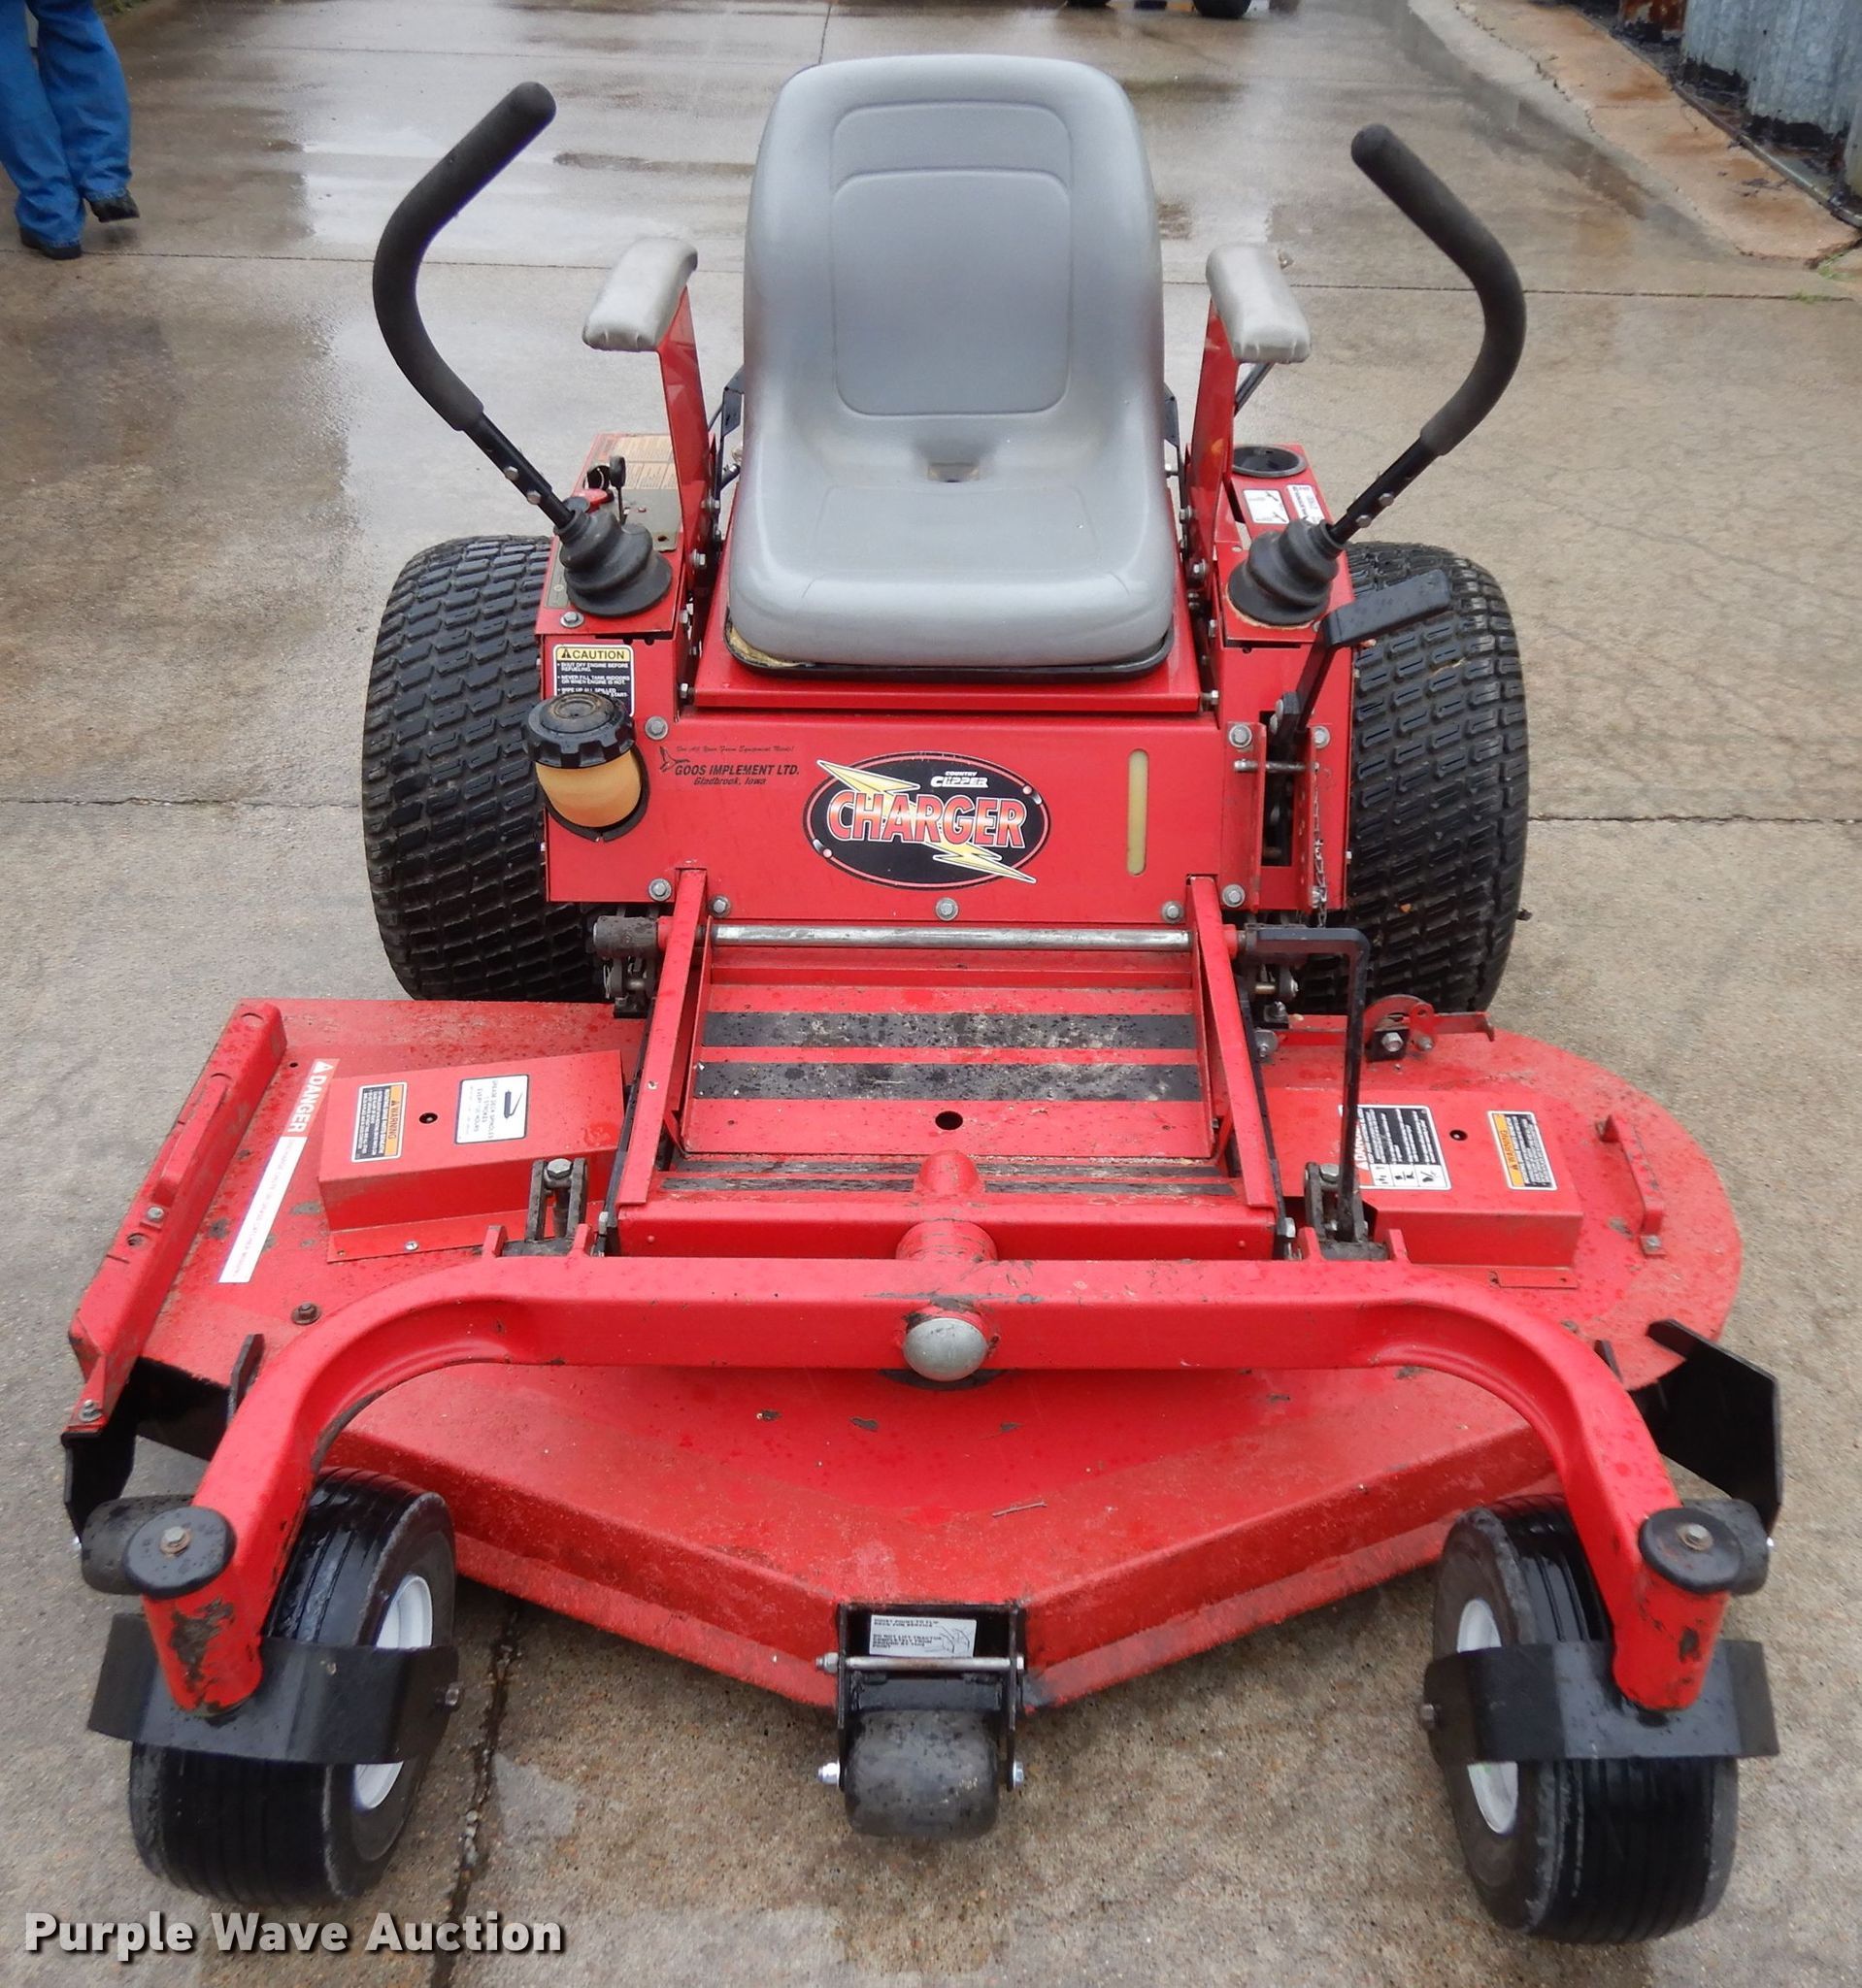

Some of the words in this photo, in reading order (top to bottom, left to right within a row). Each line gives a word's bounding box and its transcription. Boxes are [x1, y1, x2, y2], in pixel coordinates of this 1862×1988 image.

[572, 649, 625, 660] CAUTION
[675, 765, 707, 776] GOOS
[709, 765, 775, 776] IMPLEMENT
[777, 765, 800, 776] LTD.
[827, 790, 1027, 848] CHARGER
[287, 1075, 327, 1133] DANGER
[387, 1106, 399, 1141] WARNING
